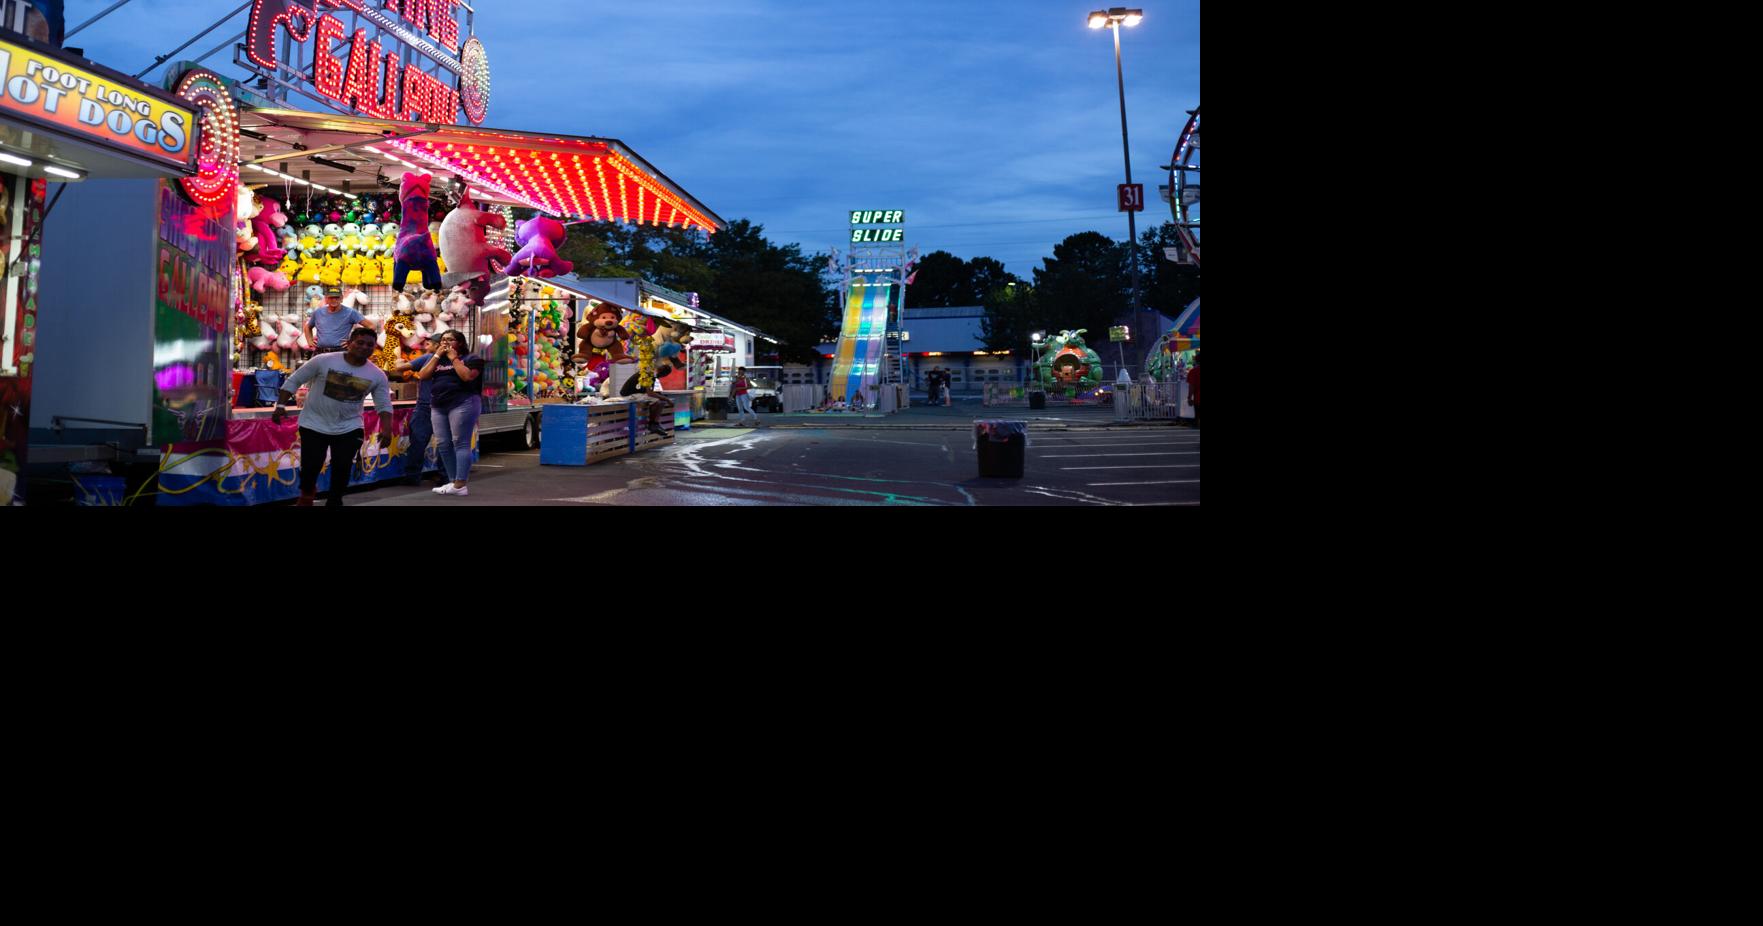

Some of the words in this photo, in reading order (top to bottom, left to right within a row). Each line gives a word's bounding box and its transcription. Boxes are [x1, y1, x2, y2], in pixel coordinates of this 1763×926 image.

[26, 58, 91, 94] FOOT
[96, 84, 151, 116] LONG
[78, 97, 186, 152] DOGS
[1124, 186, 1139, 206] 31
[851, 210, 902, 224] SUPER
[852, 229, 902, 242] SLIDE
